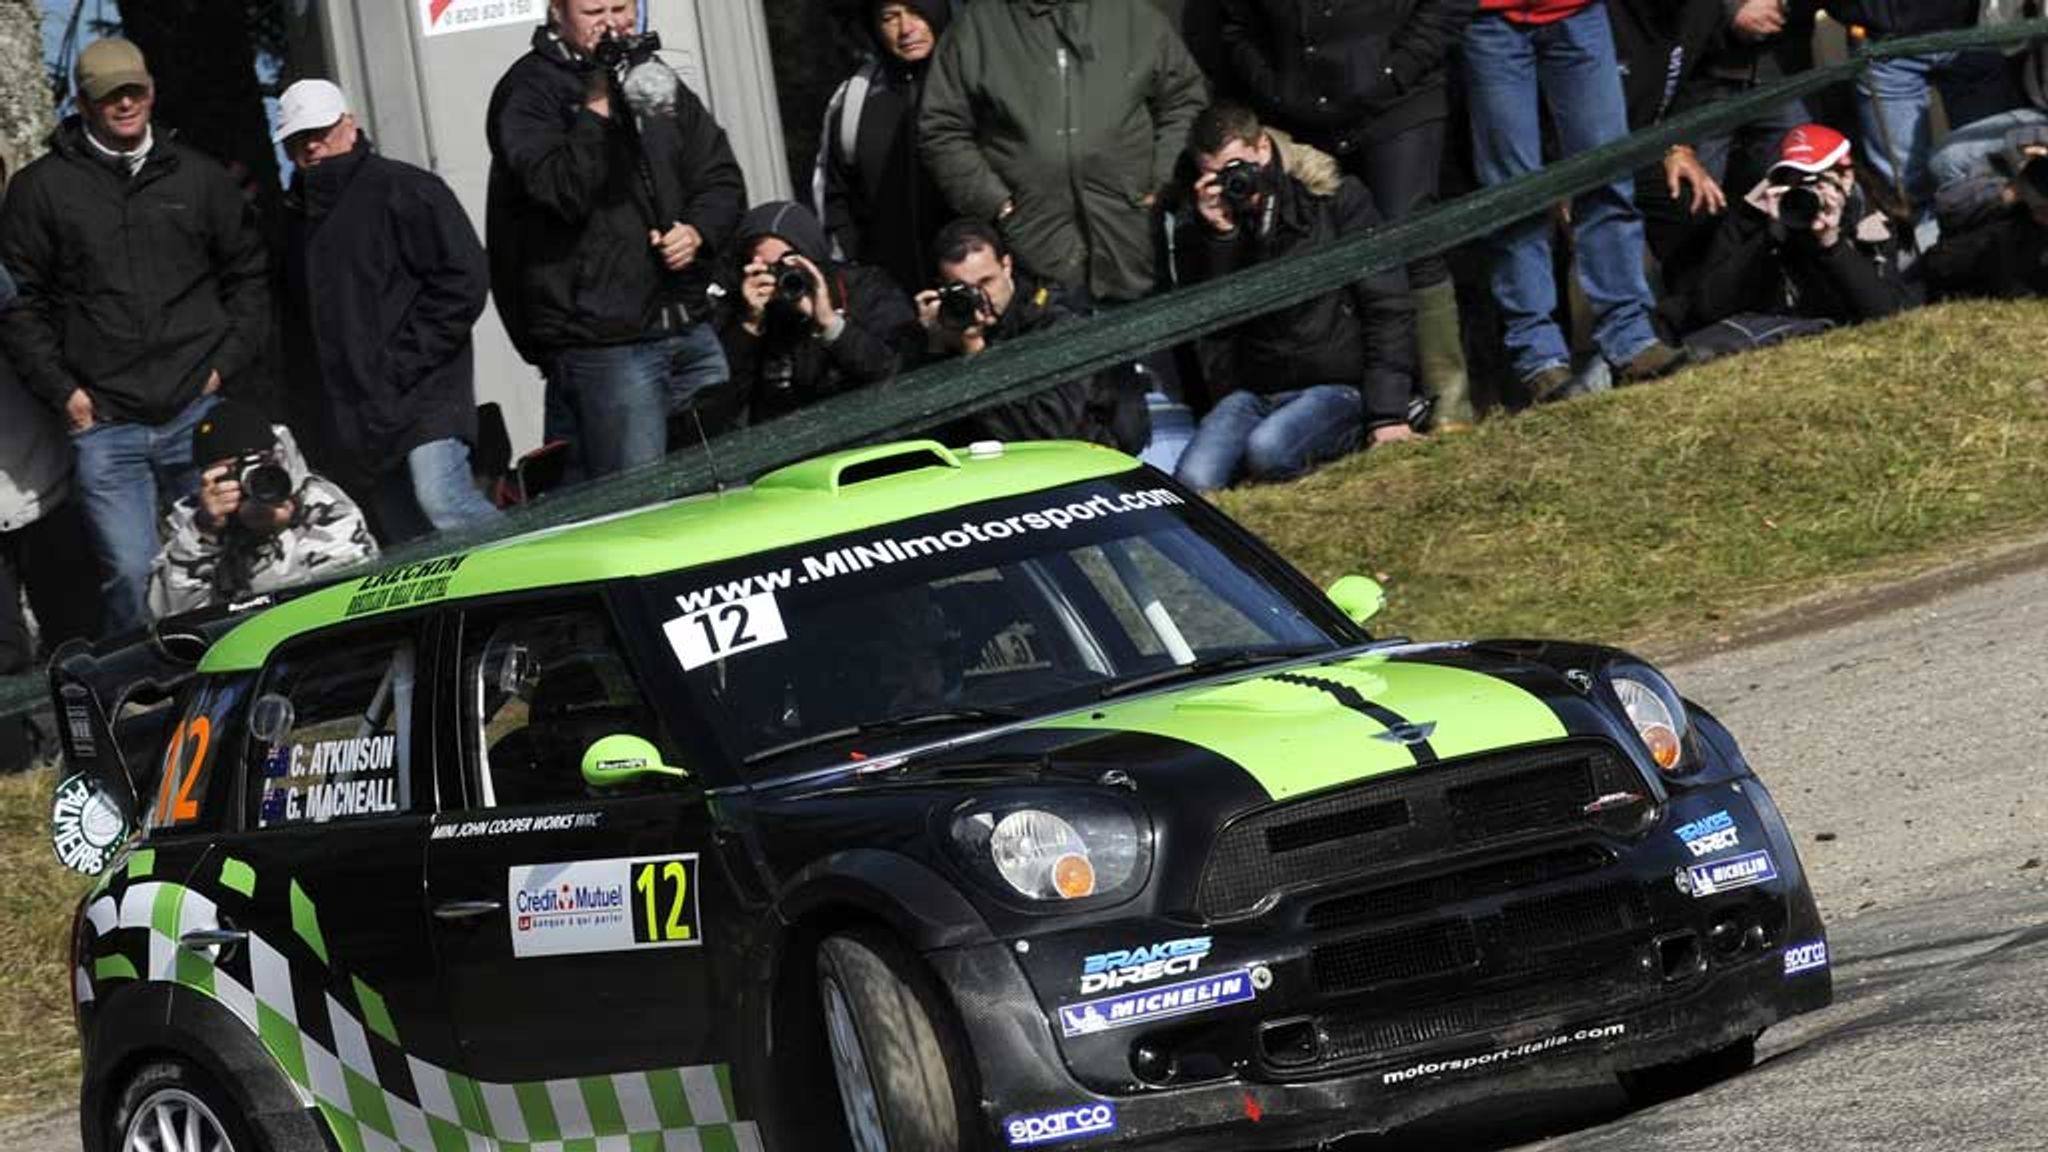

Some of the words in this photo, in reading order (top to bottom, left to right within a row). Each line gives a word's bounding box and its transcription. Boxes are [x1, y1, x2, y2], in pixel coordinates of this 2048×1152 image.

[676, 485, 1186, 615] www.MINImotorsport.com
[692, 603, 758, 654] 12
[290, 743, 306, 777] C.
[309, 736, 395, 775] ATKINSON
[286, 786, 302, 820] G.
[305, 778, 397, 819] MACNEALL
[54, 779, 104, 876] PALMEIRAS
[430, 823, 457, 840] MINI
[456, 820, 489, 838] JOHN
[488, 817, 534, 835] COOPER
[532, 814, 576, 831] WORKS
[1674, 810, 1733, 842] BRAKES
[1686, 826, 1740, 857] DIRECT
[1713, 856, 1768, 882] MICHELIN
[517, 889, 558, 912] Crédit
[576, 884, 623, 909] Mutuel
[636, 861, 691, 942] 12
[1080, 952, 1210, 995] DIRECT
[1083, 936, 1214, 974] BRAKES
[1783, 941, 1826, 970] sparco
[1110, 978, 1242, 1020] MICHELIN
[1383, 1024, 1625, 1084] motorsport-italia.com
[1008, 1105, 1111, 1143] sparco
